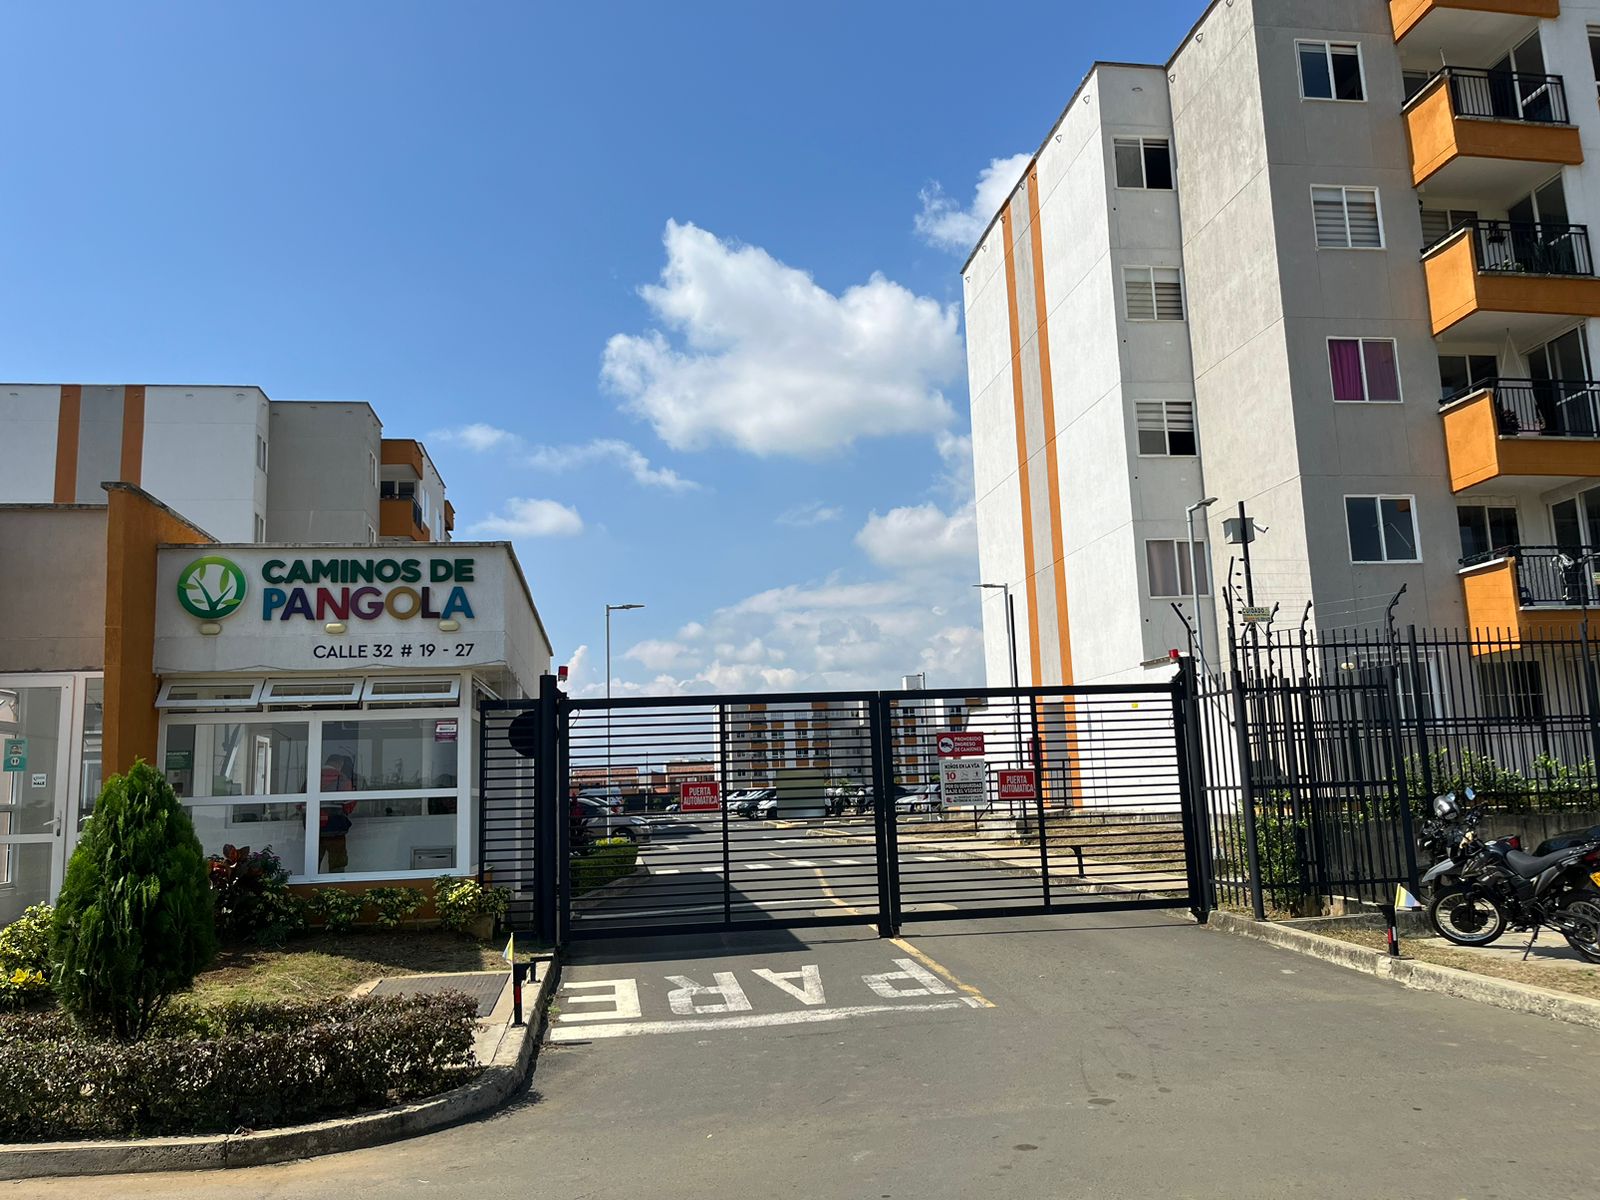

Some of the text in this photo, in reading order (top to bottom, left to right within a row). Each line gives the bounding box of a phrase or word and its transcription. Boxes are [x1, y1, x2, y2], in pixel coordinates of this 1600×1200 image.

[262, 559, 475, 584] CAMINOS DE
[262, 586, 475, 621] PANGOLA
[313, 645, 367, 659] CALLE
[373, 644, 393, 658] 32
[401, 644, 412, 658] #
[420, 644, 436, 657] 19
[455, 643, 475, 657] 27
[945, 772, 957, 780] 10
[689, 787, 711, 796] PUERTA
[1001, 784, 1034, 792] AUTOMATICA
[683, 796, 718, 805] AUTOMATICA
[559, 958, 957, 1020] PARE
